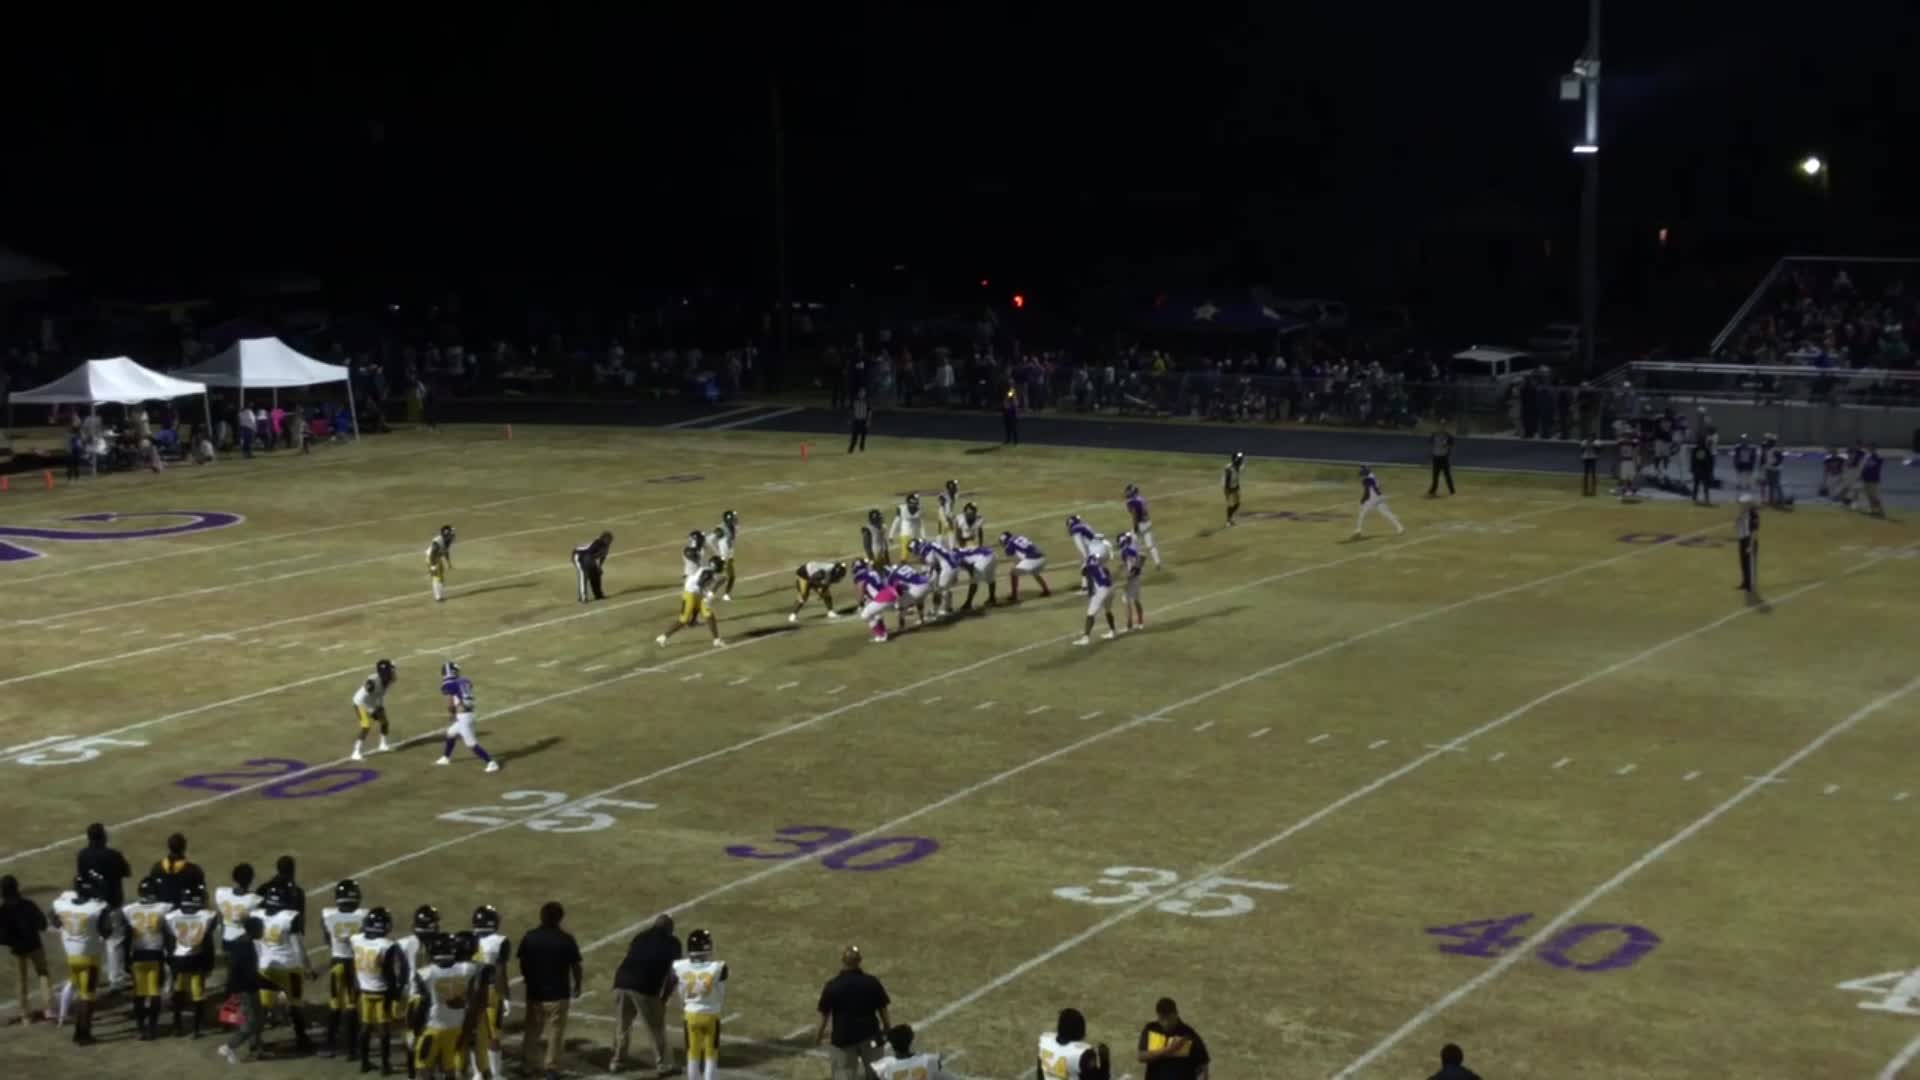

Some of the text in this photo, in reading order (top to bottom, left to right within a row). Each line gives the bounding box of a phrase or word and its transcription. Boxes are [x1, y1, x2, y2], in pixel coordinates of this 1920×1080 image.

[176, 758, 381, 799] 20
[437, 789, 658, 833] 25
[724, 825, 940, 872] 30
[1052, 866, 1290, 918] 35
[1425, 911, 1662, 973] 40
